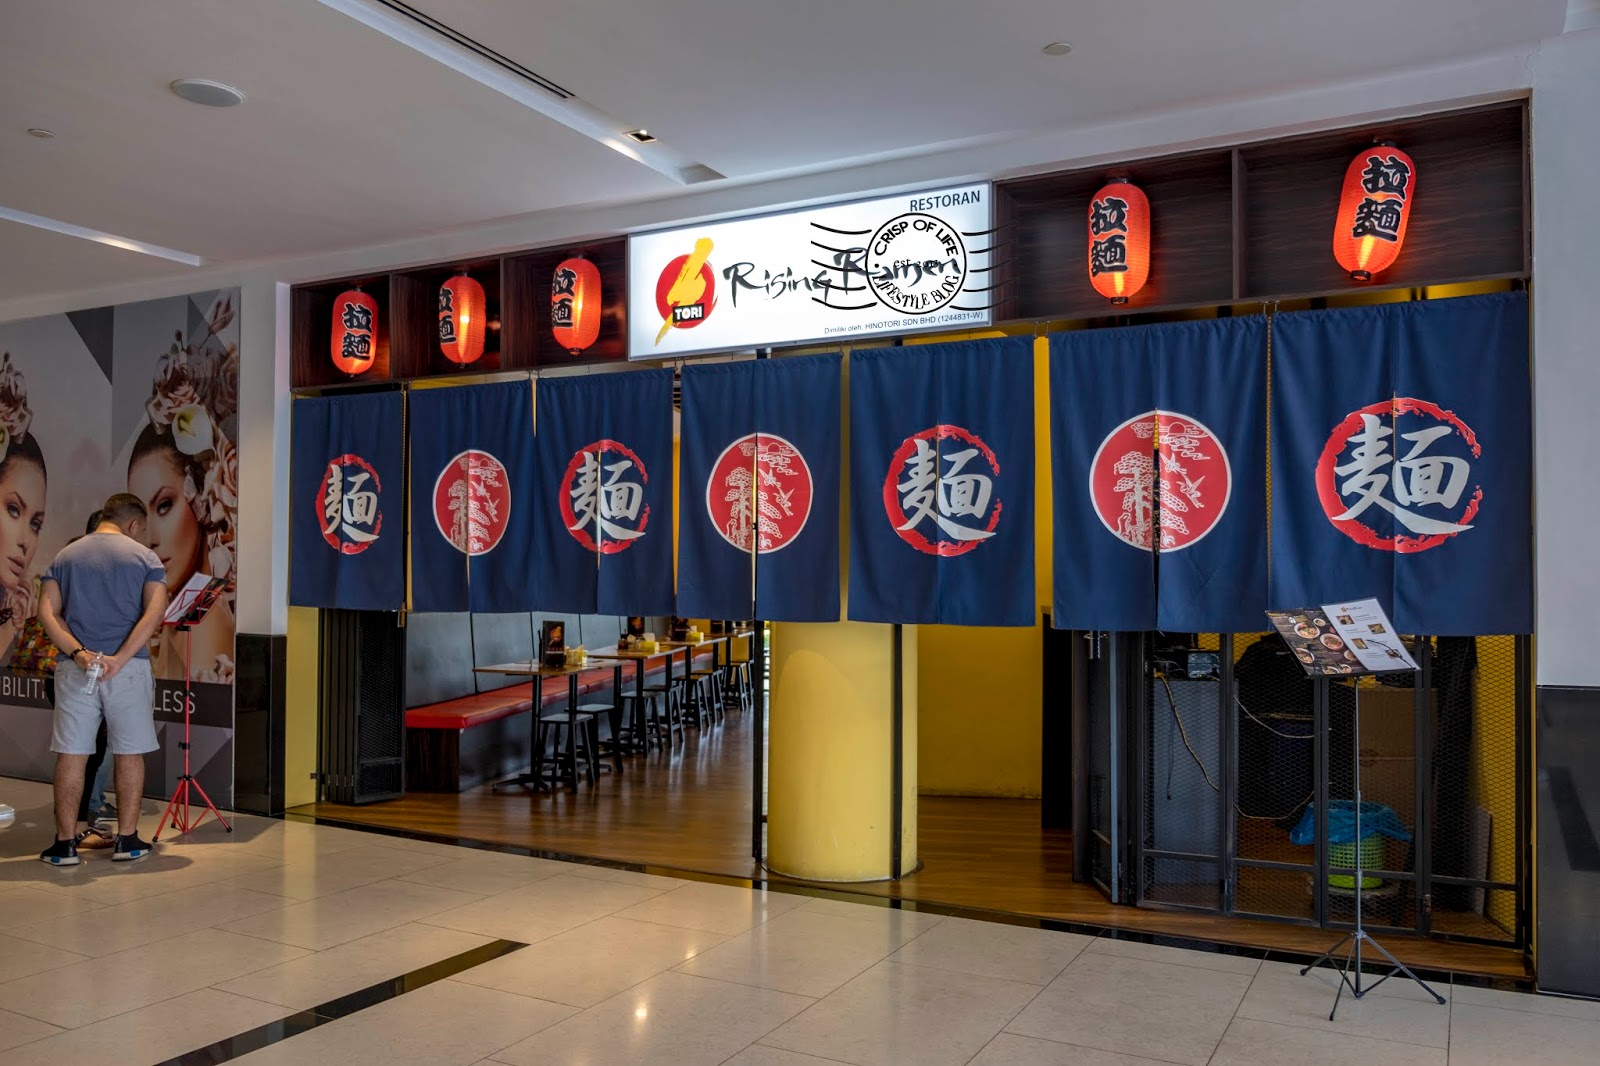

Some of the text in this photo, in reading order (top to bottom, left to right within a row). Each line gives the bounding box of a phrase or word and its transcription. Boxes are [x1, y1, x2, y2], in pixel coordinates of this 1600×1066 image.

[910, 191, 981, 213] RESTORAN
[723, 262, 833, 308] Rising
[674, 306, 703, 320] TORI
[865, 320, 901, 331] HINOTORI
[902, 318, 919, 327] SDN
[920, 315, 936, 325] BHD
[938, 311, 984, 324] (1244831-W)
